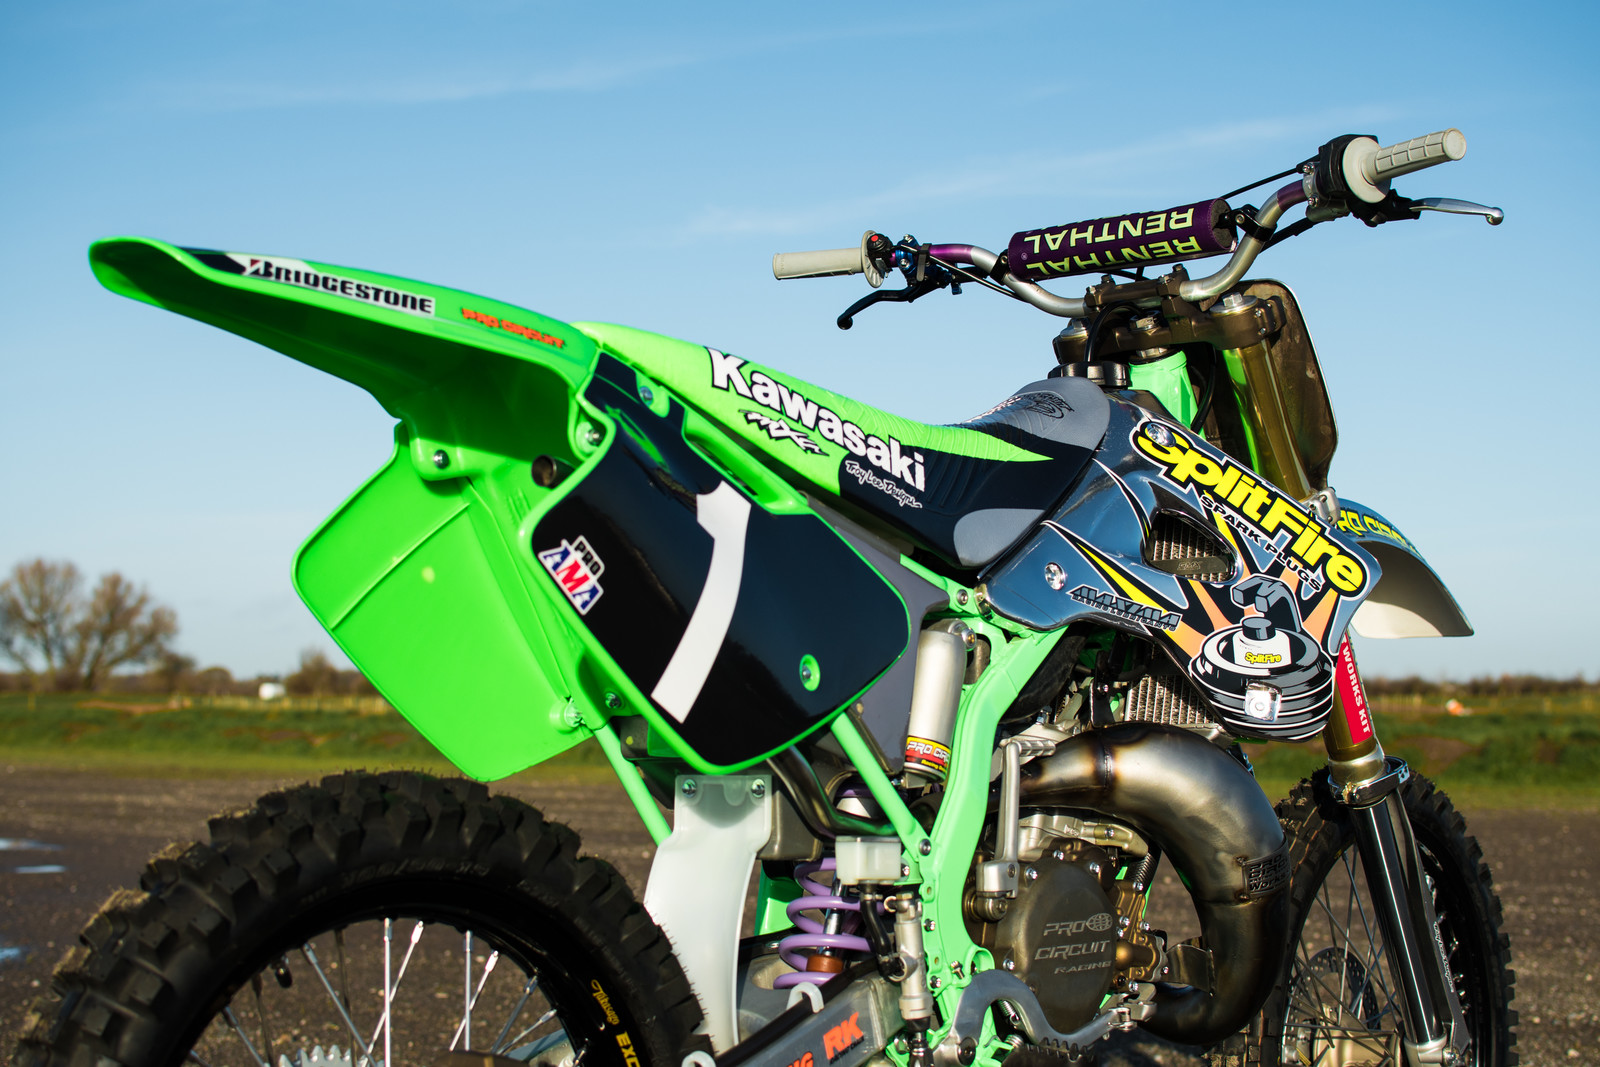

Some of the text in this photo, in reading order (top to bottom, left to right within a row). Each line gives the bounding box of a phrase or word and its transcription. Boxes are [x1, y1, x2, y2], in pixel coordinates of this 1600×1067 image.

[1023, 207, 1195, 254] RENTHAL
[1026, 236, 1203, 276] RENTHAL
[249, 258, 432, 314] BRIDGESTONE
[704, 345, 925, 492] Kawasaki
[1136, 421, 1365, 593] SplitFire
[574, 540, 601, 576] PRO
[1200, 495, 1322, 592] SPARK PLUGS
[542, 546, 600, 610] AMA
[650, 480, 752, 724] 1
[1245, 652, 1282, 665] SplitFire
[1342, 645, 1363, 707] WORKS
[1358, 708, 1371, 733] KIT
[907, 741, 933, 755] PRO
[1034, 940, 1110, 960] CIRCUIT
[1043, 920, 1086, 937] PRO
[1054, 961, 1112, 974] RACING
[590, 979, 620, 1026] Takasago
[823, 1011, 864, 1060] RK
